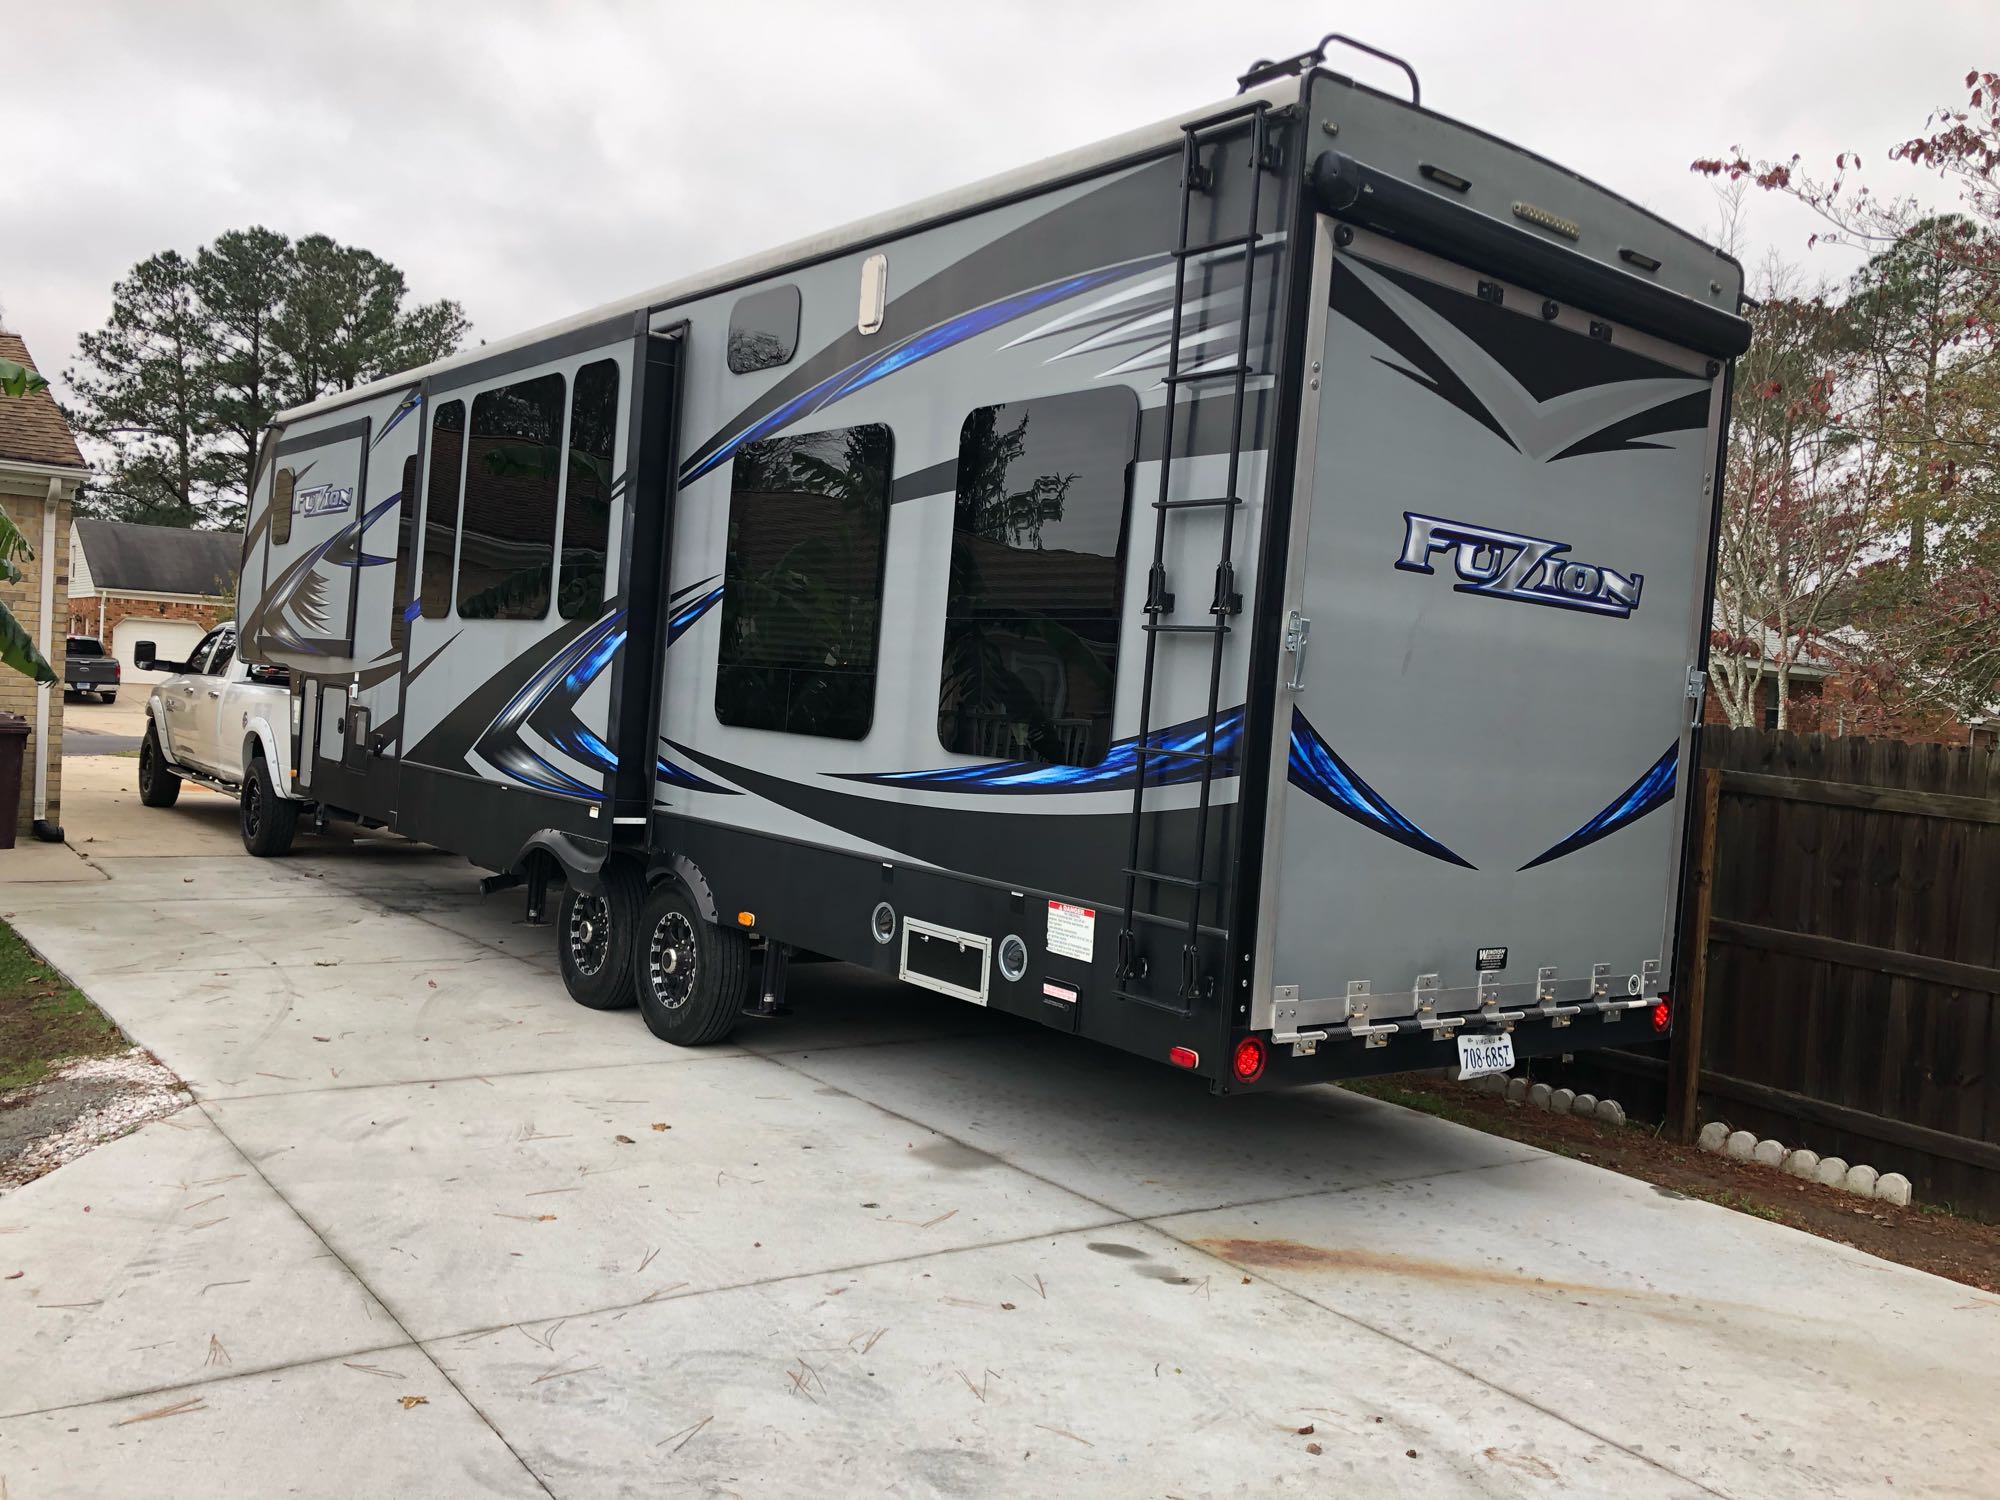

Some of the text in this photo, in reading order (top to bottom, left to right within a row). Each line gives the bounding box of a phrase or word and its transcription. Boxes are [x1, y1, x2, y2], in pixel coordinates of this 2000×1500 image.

[292, 483, 353, 518] FUZION
[1394, 511, 1644, 620] FUZION
[1062, 904, 1085, 916] DANGER
